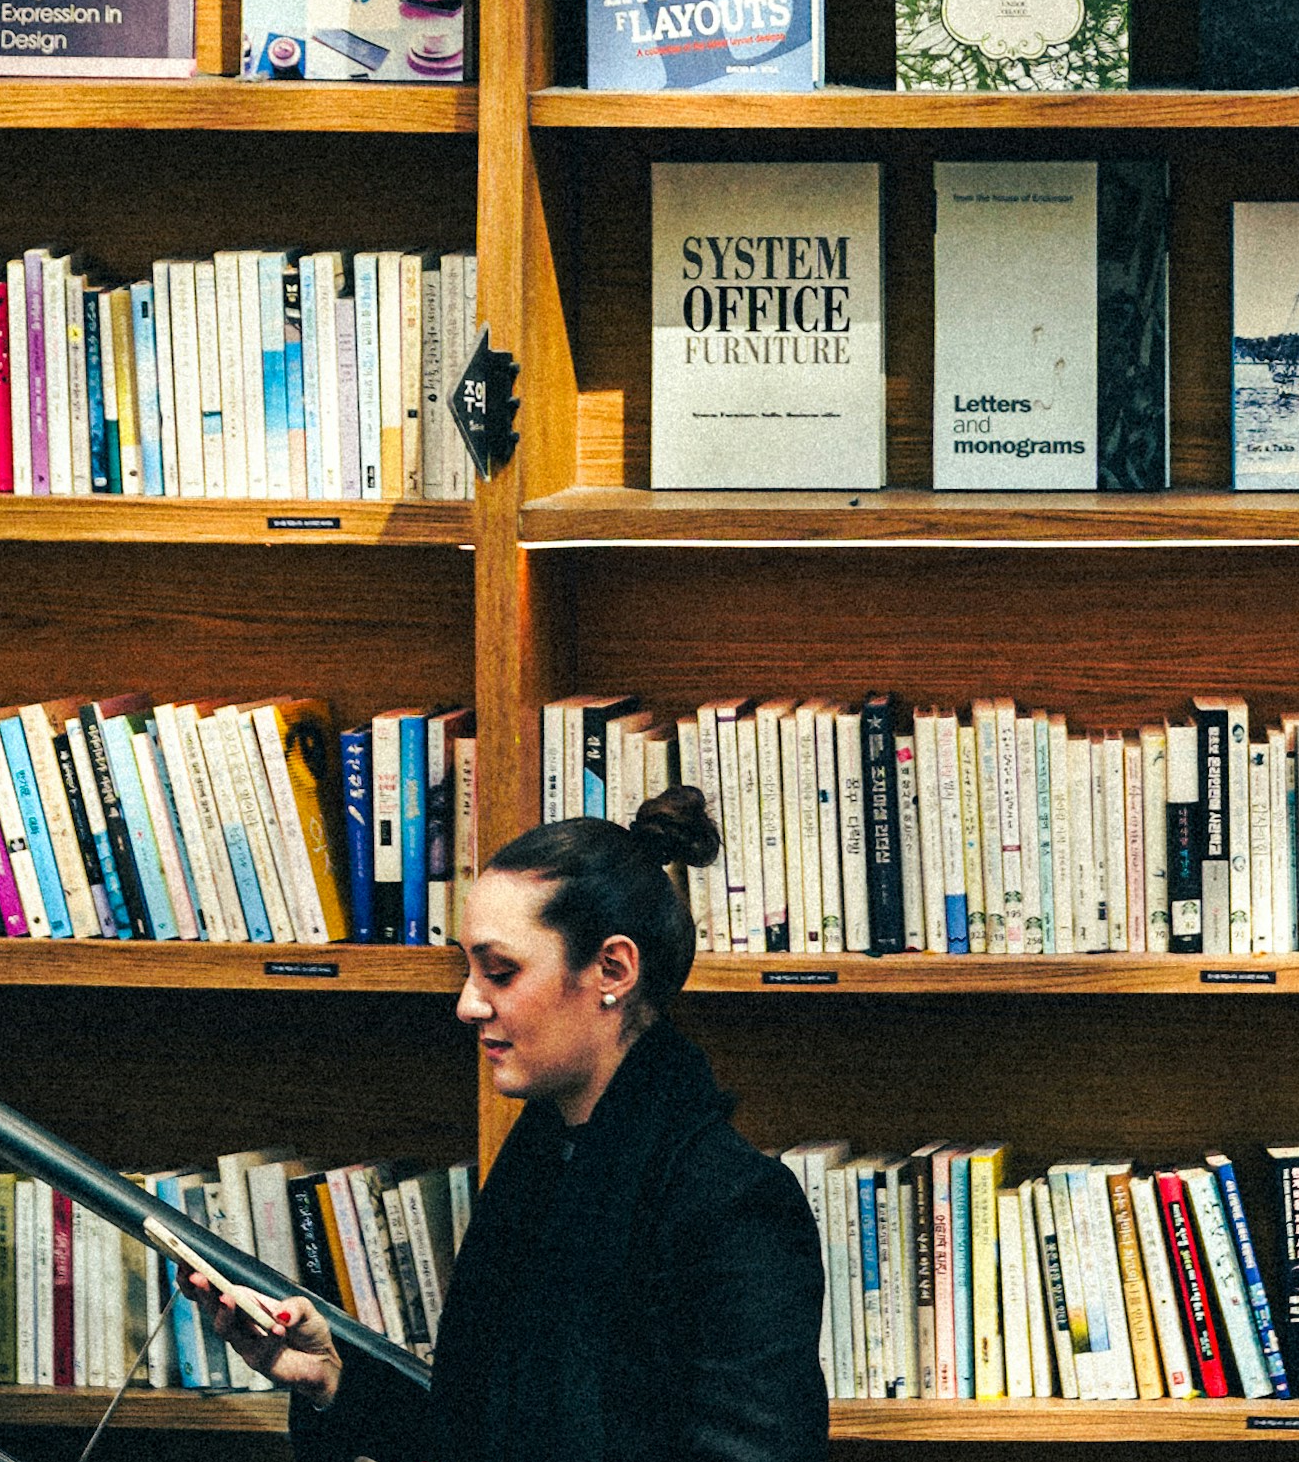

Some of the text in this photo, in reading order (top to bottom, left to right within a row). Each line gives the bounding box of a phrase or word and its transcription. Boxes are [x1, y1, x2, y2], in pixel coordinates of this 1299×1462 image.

[2, 3, 122, 24] Expression in
[1, 30, 67, 54] Design
[683, 236, 848, 279] SYSTEM
[683, 286, 849, 332] OFFICE
[686, 336, 850, 364] FURNITURE
[463, 380, 487, 414] 주의
[954, 395, 1032, 413] Letters
[953, 417, 991, 434] and
[954, 438, 1086, 458] monograms
